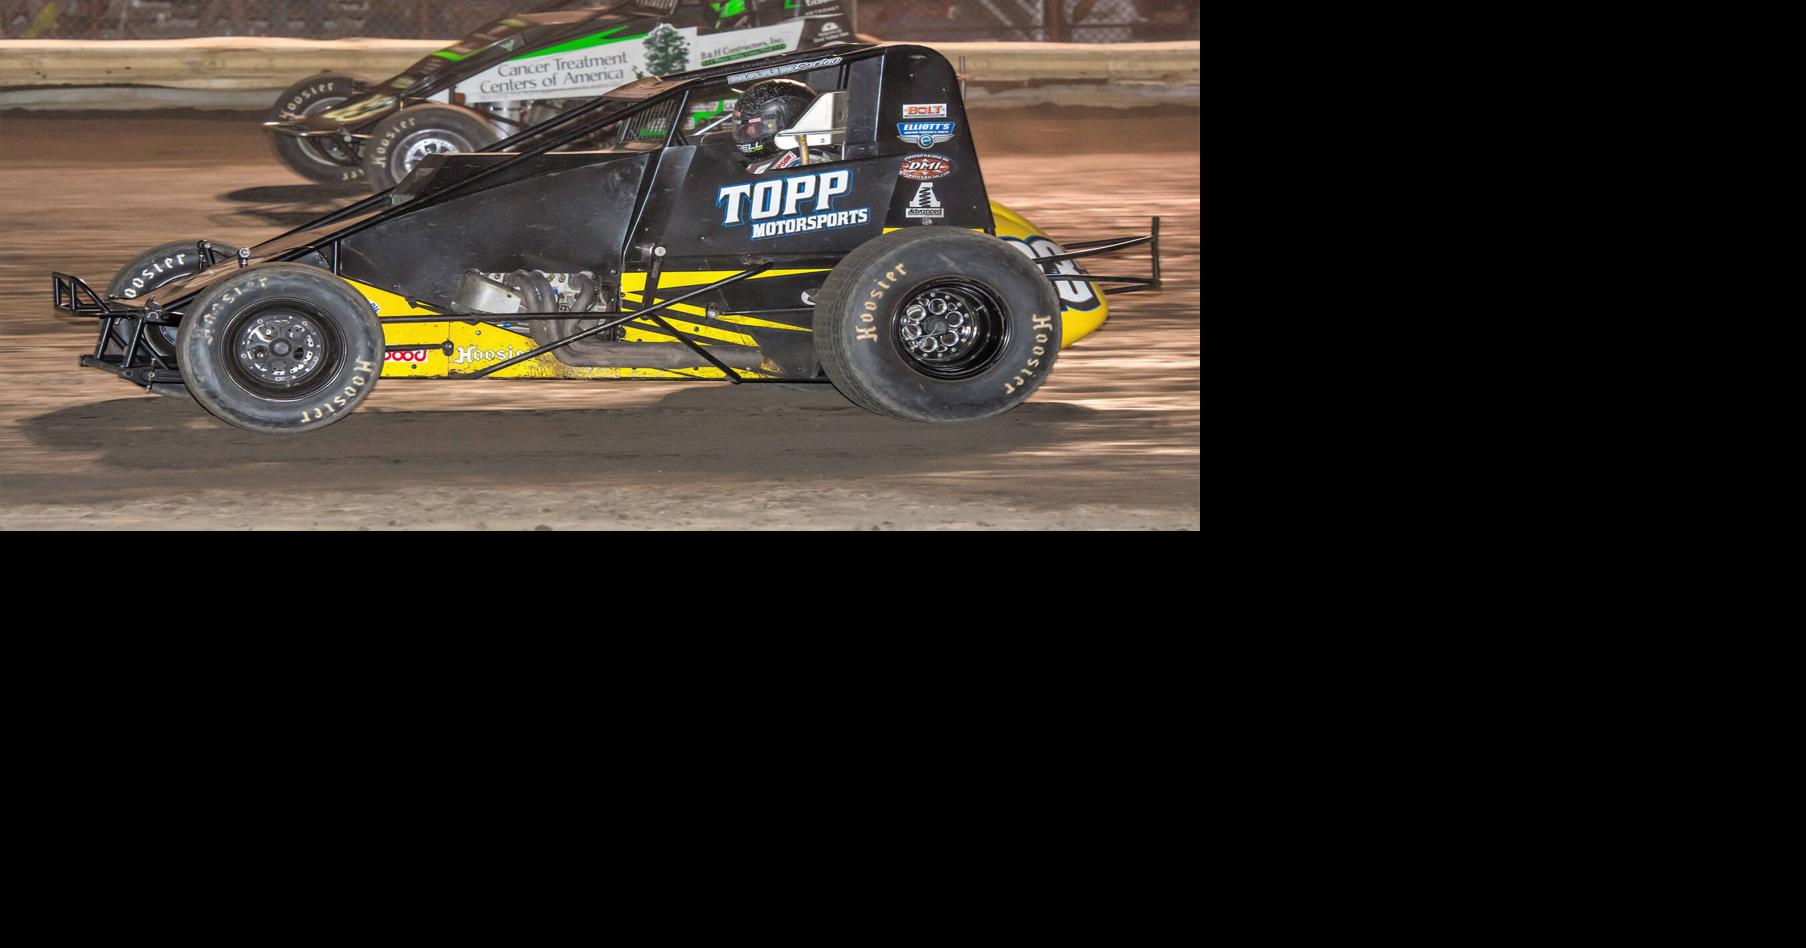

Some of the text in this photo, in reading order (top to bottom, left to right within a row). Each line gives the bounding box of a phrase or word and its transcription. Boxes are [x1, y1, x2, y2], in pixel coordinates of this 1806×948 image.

[480, 78, 537, 94] Centers
[542, 73, 558, 87] of
[563, 67, 624, 85] America
[498, 51, 628, 78] Cancer Treatment
[279, 81, 335, 121] Hoosier
[907, 104, 943, 115] BOLT
[371, 117, 416, 168] Hoosier
[903, 123, 950, 131] ELLIOTT'S
[908, 161, 941, 170] DMI
[717, 169, 850, 225] TOPP
[752, 207, 869, 239] MOTORSPORTS
[123, 251, 187, 299] oosier
[855, 262, 908, 342] Hoosier
[453, 345, 533, 365] Hoosie
[1003, 313, 1054, 395] Hoosier
[300, 355, 376, 424] Hoosier
